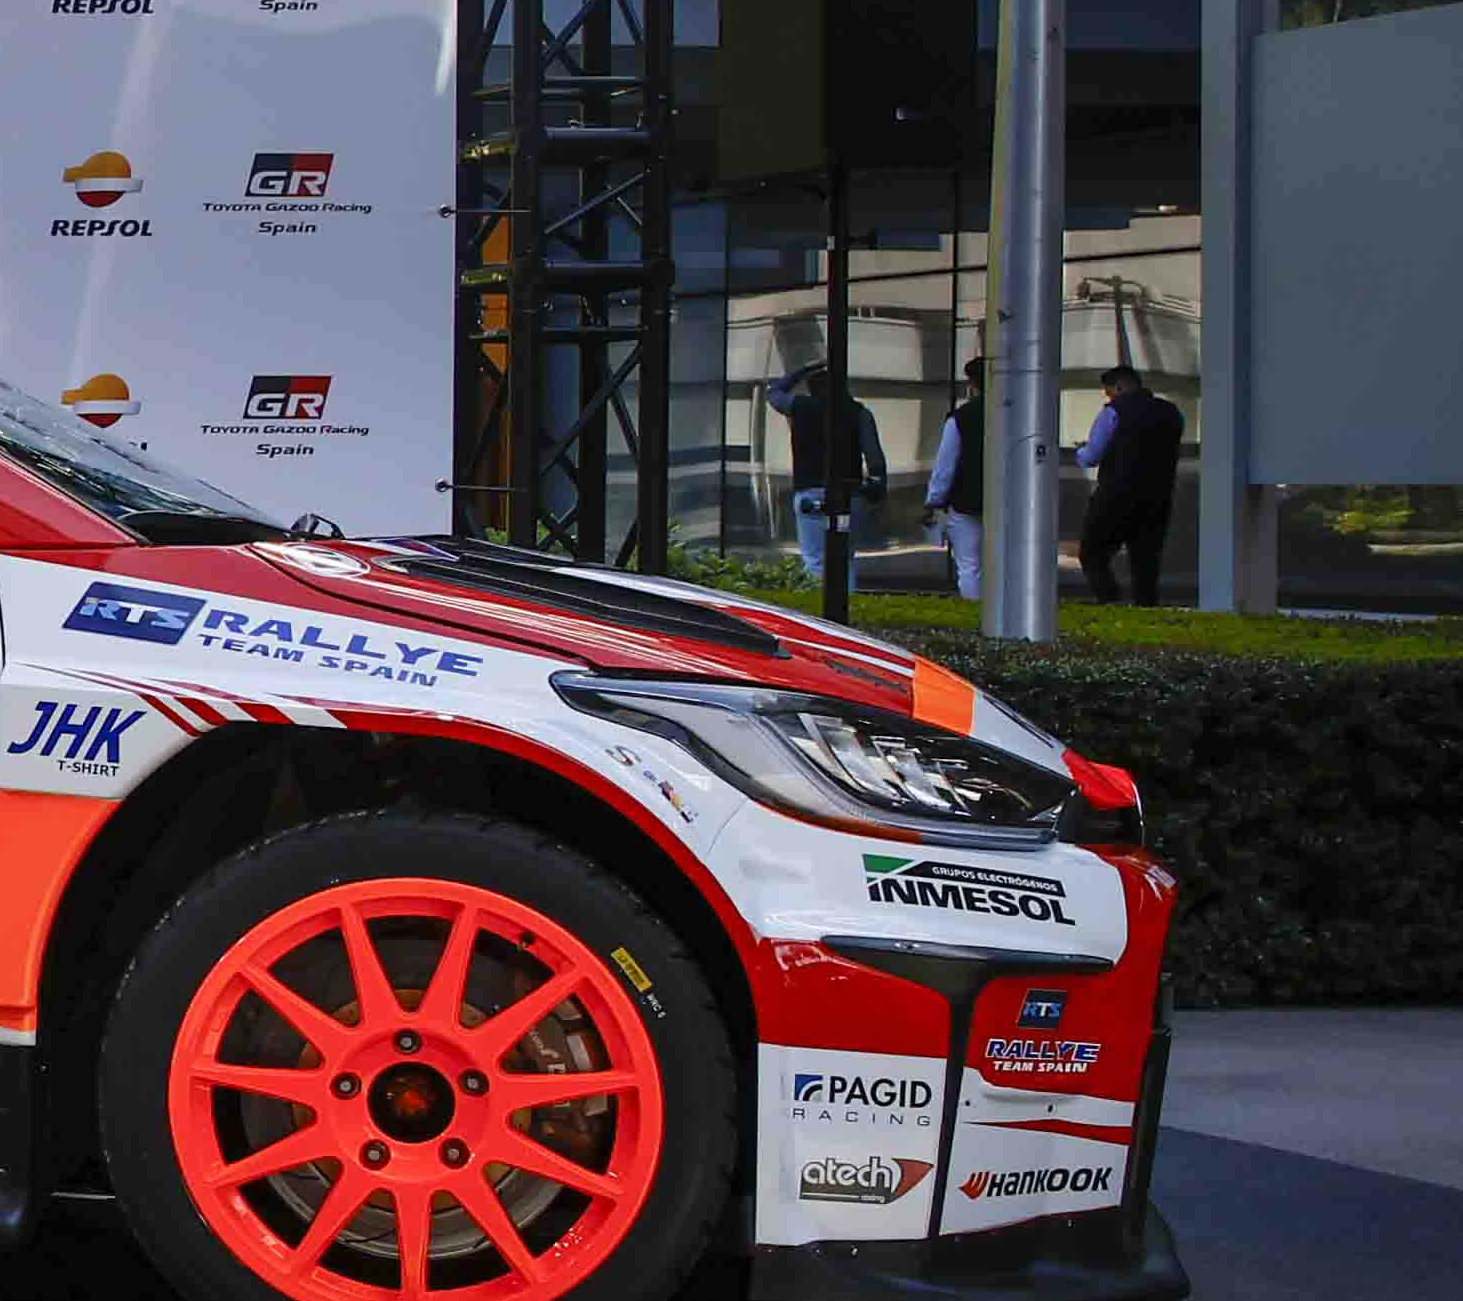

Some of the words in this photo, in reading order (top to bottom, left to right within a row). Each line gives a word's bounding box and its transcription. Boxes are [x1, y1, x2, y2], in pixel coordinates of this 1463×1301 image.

[259, 0, 317, 14] Spain
[251, 170, 325, 195] GR
[203, 203, 261, 211] TOYOTA
[265, 203, 319, 212] GAZOO
[322, 203, 371, 214] Racing
[51, 220, 152, 236] REPSOL
[259, 222, 316, 236] Spain
[249, 392, 323, 418] GR
[201, 425, 259, 434] TOYOTA
[263, 425, 316, 434] GAZOO
[320, 425, 369, 436] Racing
[256, 444, 314, 458] Spain
[78, 595, 194, 629] RTS
[204, 609, 484, 677] RALLYE
[197, 635, 304, 662] TEAM
[318, 656, 437, 686] SPAIN
[7, 700, 146, 763] JHK
[58, 759, 119, 777] T-SHIRT
[932, 867, 975, 880] GRUPOS
[1023, 1002, 1063, 1019] RTS
[986, 1038, 1101, 1061] RALLYE
[993, 1062, 1034, 1072] TEAM
[1038, 1062, 1088, 1073] SPAIN
[829, 1077, 932, 1108] PAGID
[793, 1107, 931, 1126] RACING
[803, 1157, 889, 1188] atech
